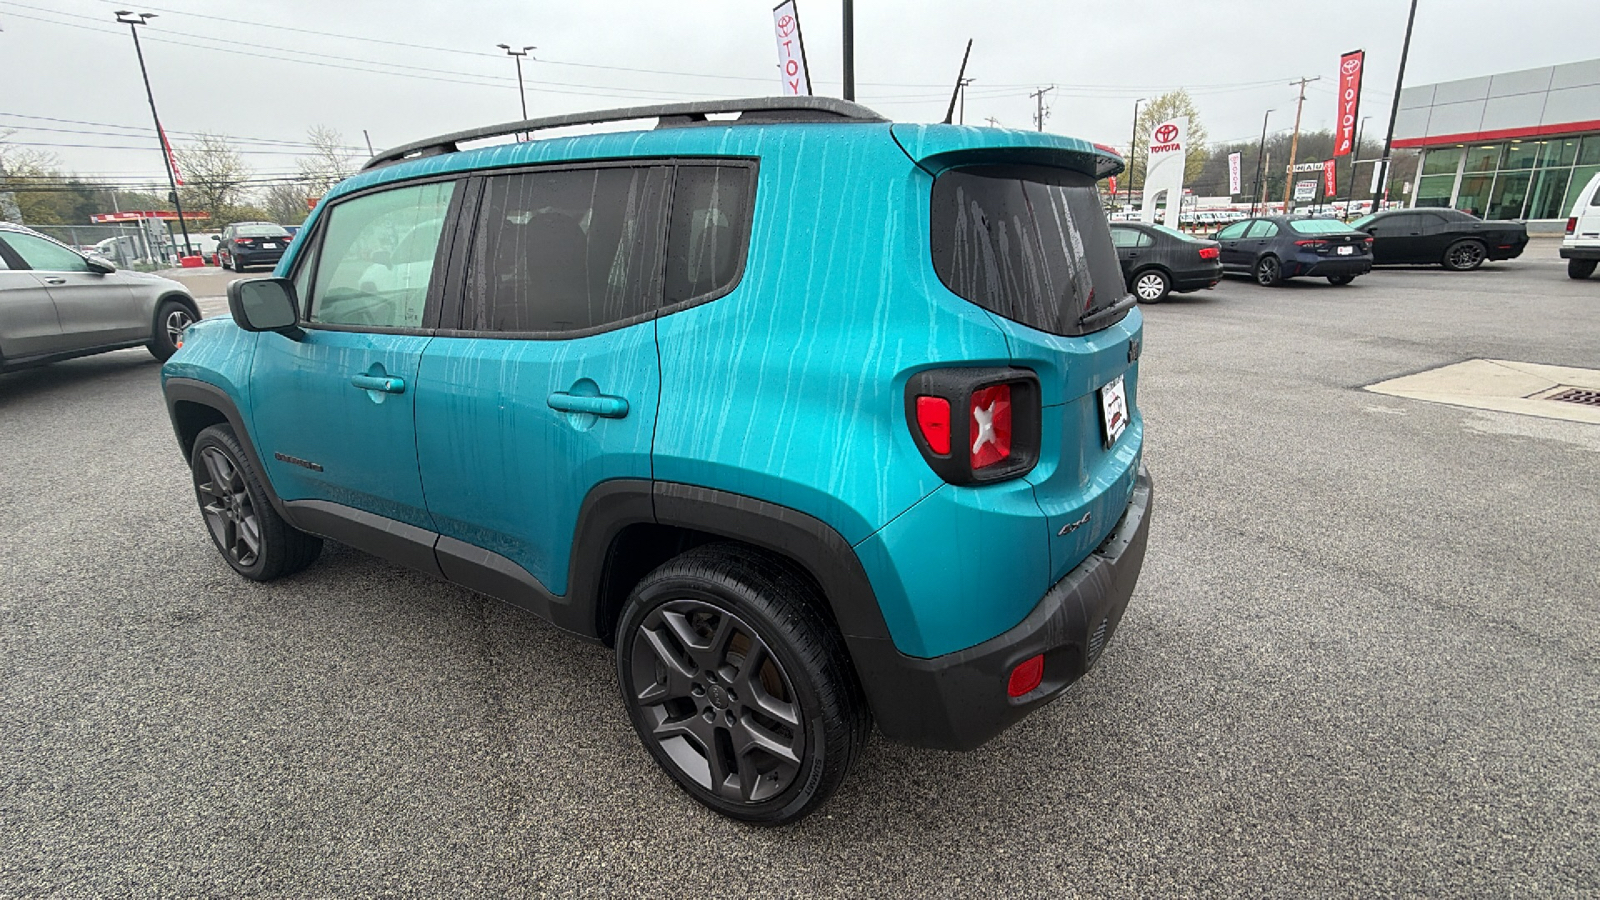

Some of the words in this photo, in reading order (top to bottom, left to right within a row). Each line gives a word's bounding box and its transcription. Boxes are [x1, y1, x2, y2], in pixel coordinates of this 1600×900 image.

[782, 40, 799, 95] TOY
[1340, 76, 1354, 151] TOYOTA
[1150, 143, 1180, 154] TOYOTA
